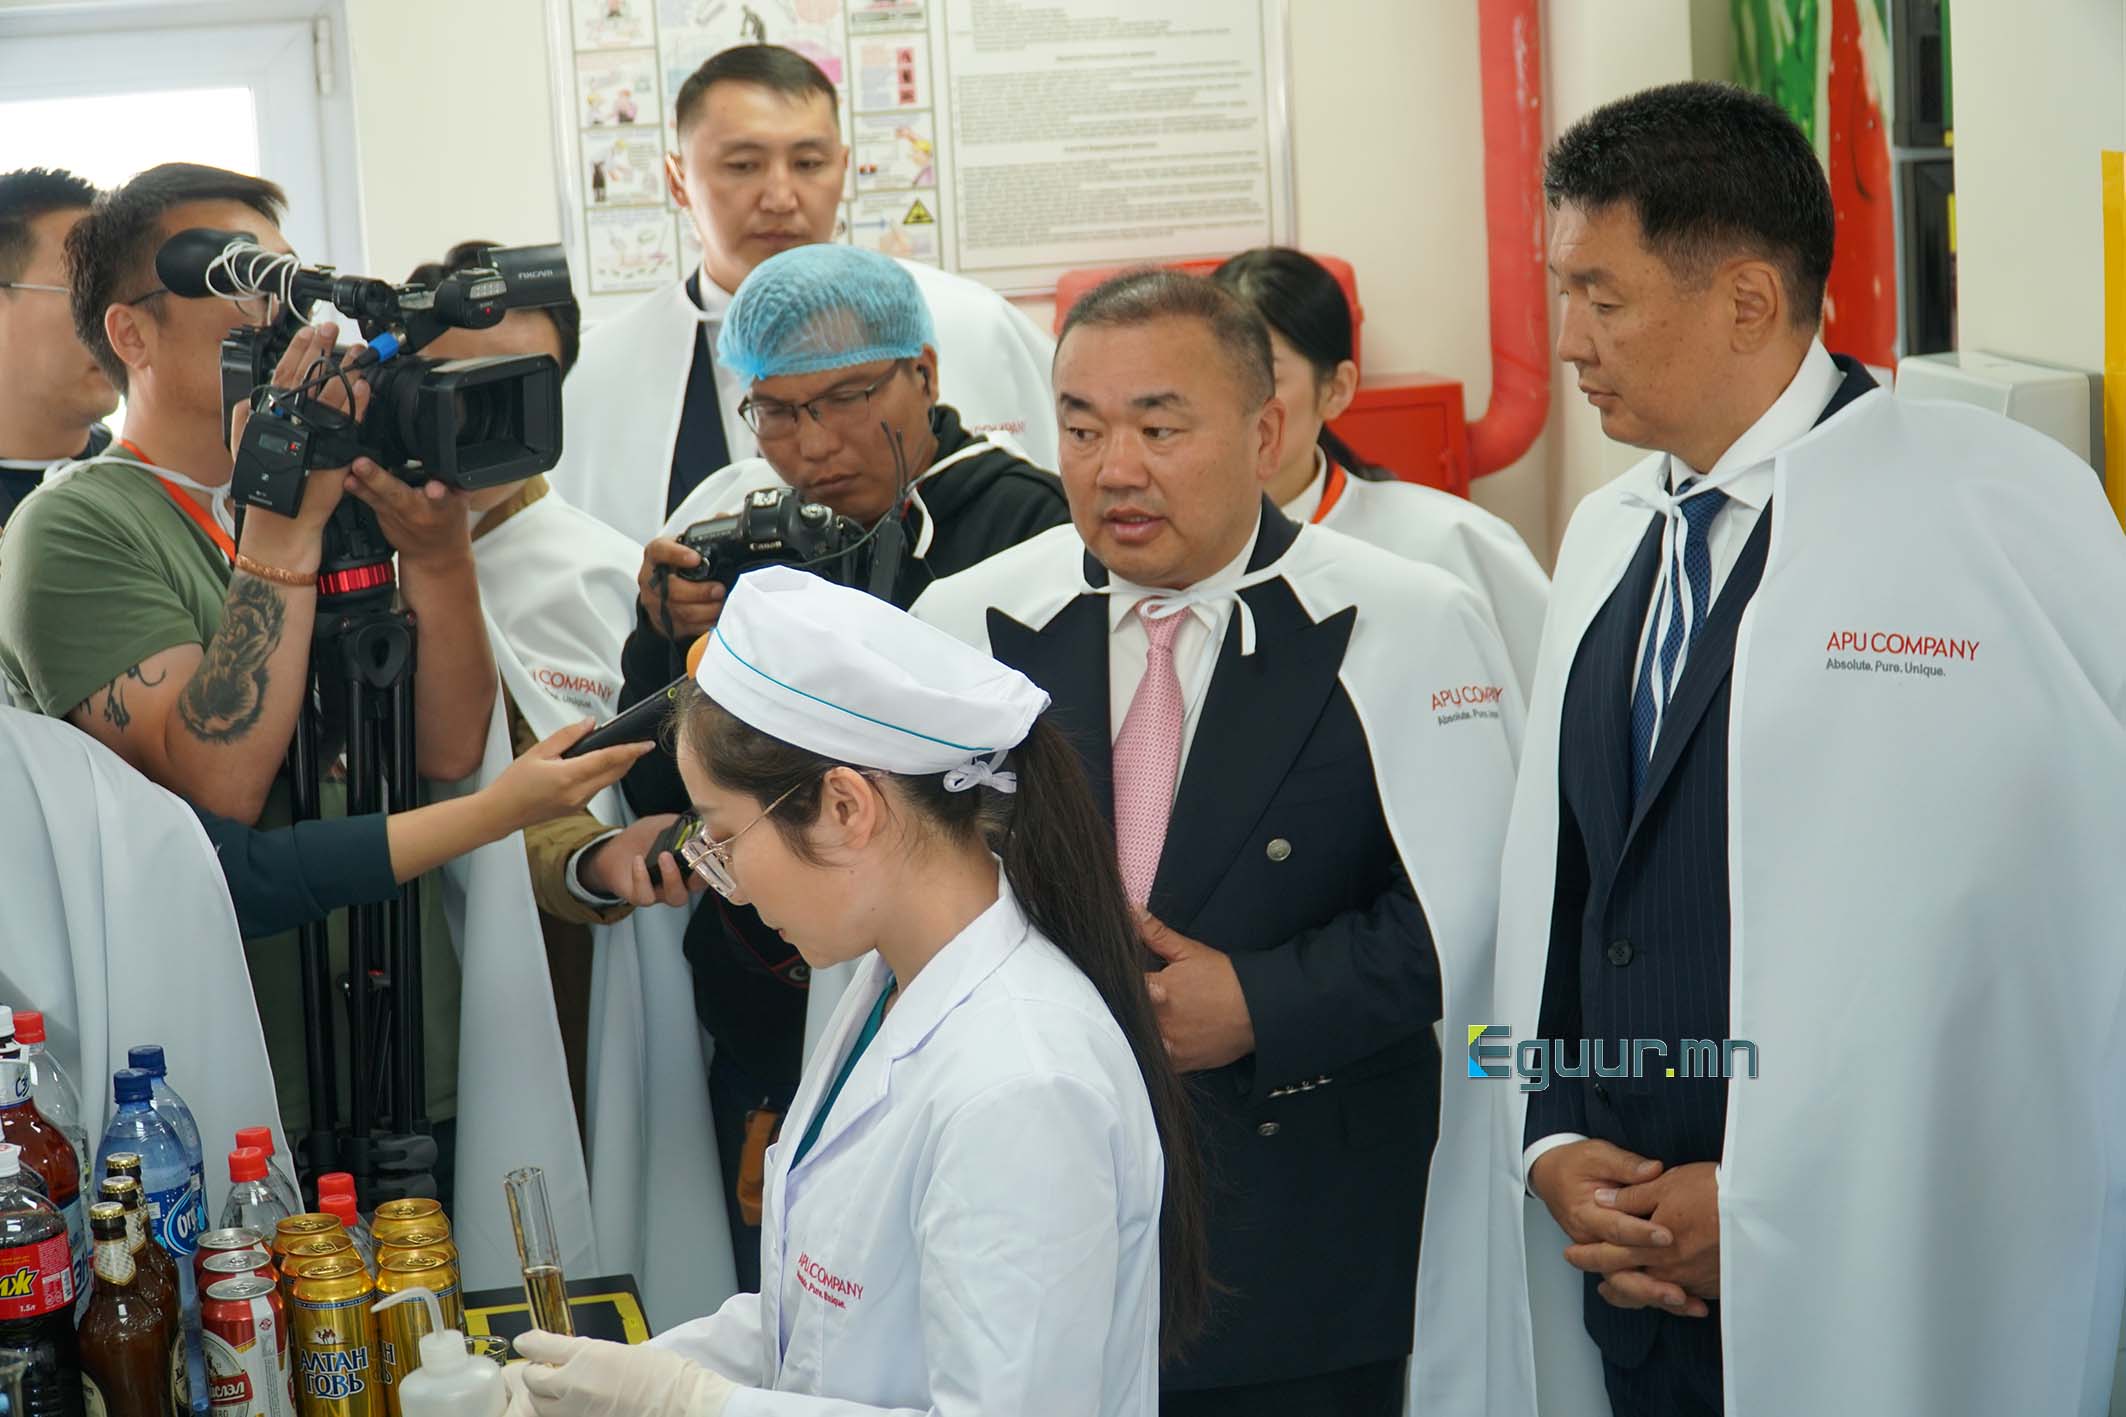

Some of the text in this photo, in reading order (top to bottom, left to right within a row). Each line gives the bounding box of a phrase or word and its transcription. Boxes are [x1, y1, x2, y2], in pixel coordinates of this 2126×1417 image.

[749, 540, 782, 551] Canon
[1826, 631, 1980, 662] APU COMPANY
[1826, 657, 1946, 678] Absolute. Pure. Unique.
[1432, 687, 1461, 711] APU
[809, 1262, 864, 1300] COMPANY
[300, 1346, 369, 1375] АЛТАН
[305, 1372, 365, 1400] ГОВЬ
